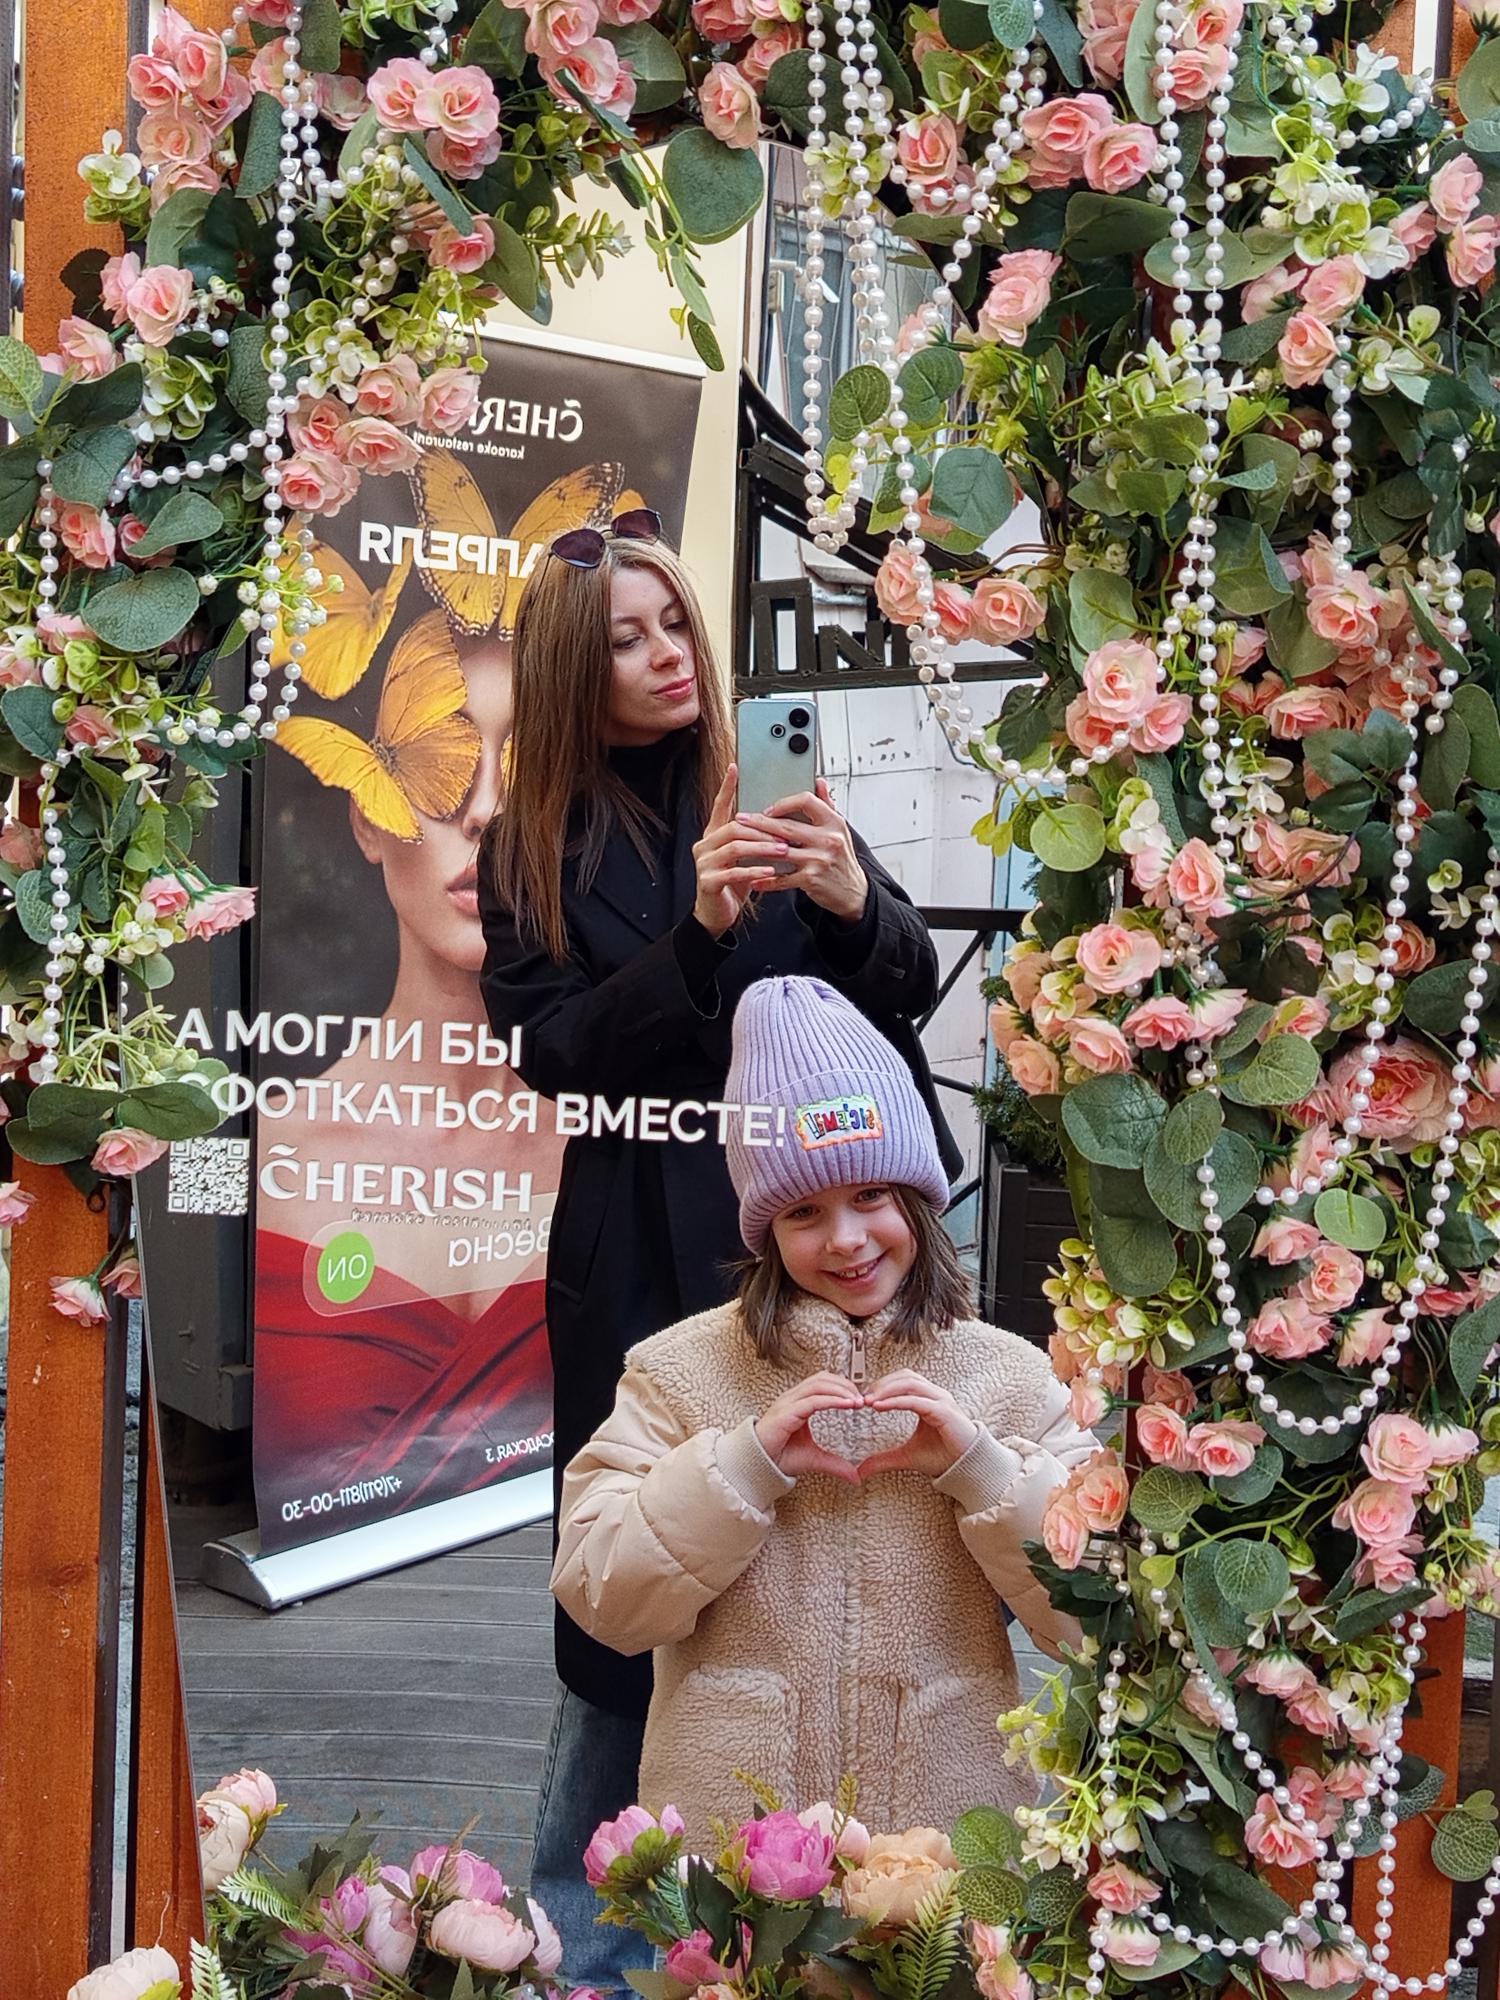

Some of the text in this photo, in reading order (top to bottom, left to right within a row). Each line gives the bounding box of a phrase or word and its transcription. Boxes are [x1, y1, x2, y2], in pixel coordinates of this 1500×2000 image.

[175, 1007, 522, 1069] А МОГЛИ БЫ
[178, 1072, 787, 1148] ФОТКАТЬСЯ ВМЕСТЕ!
[351, 1208, 425, 1225] karaoke
